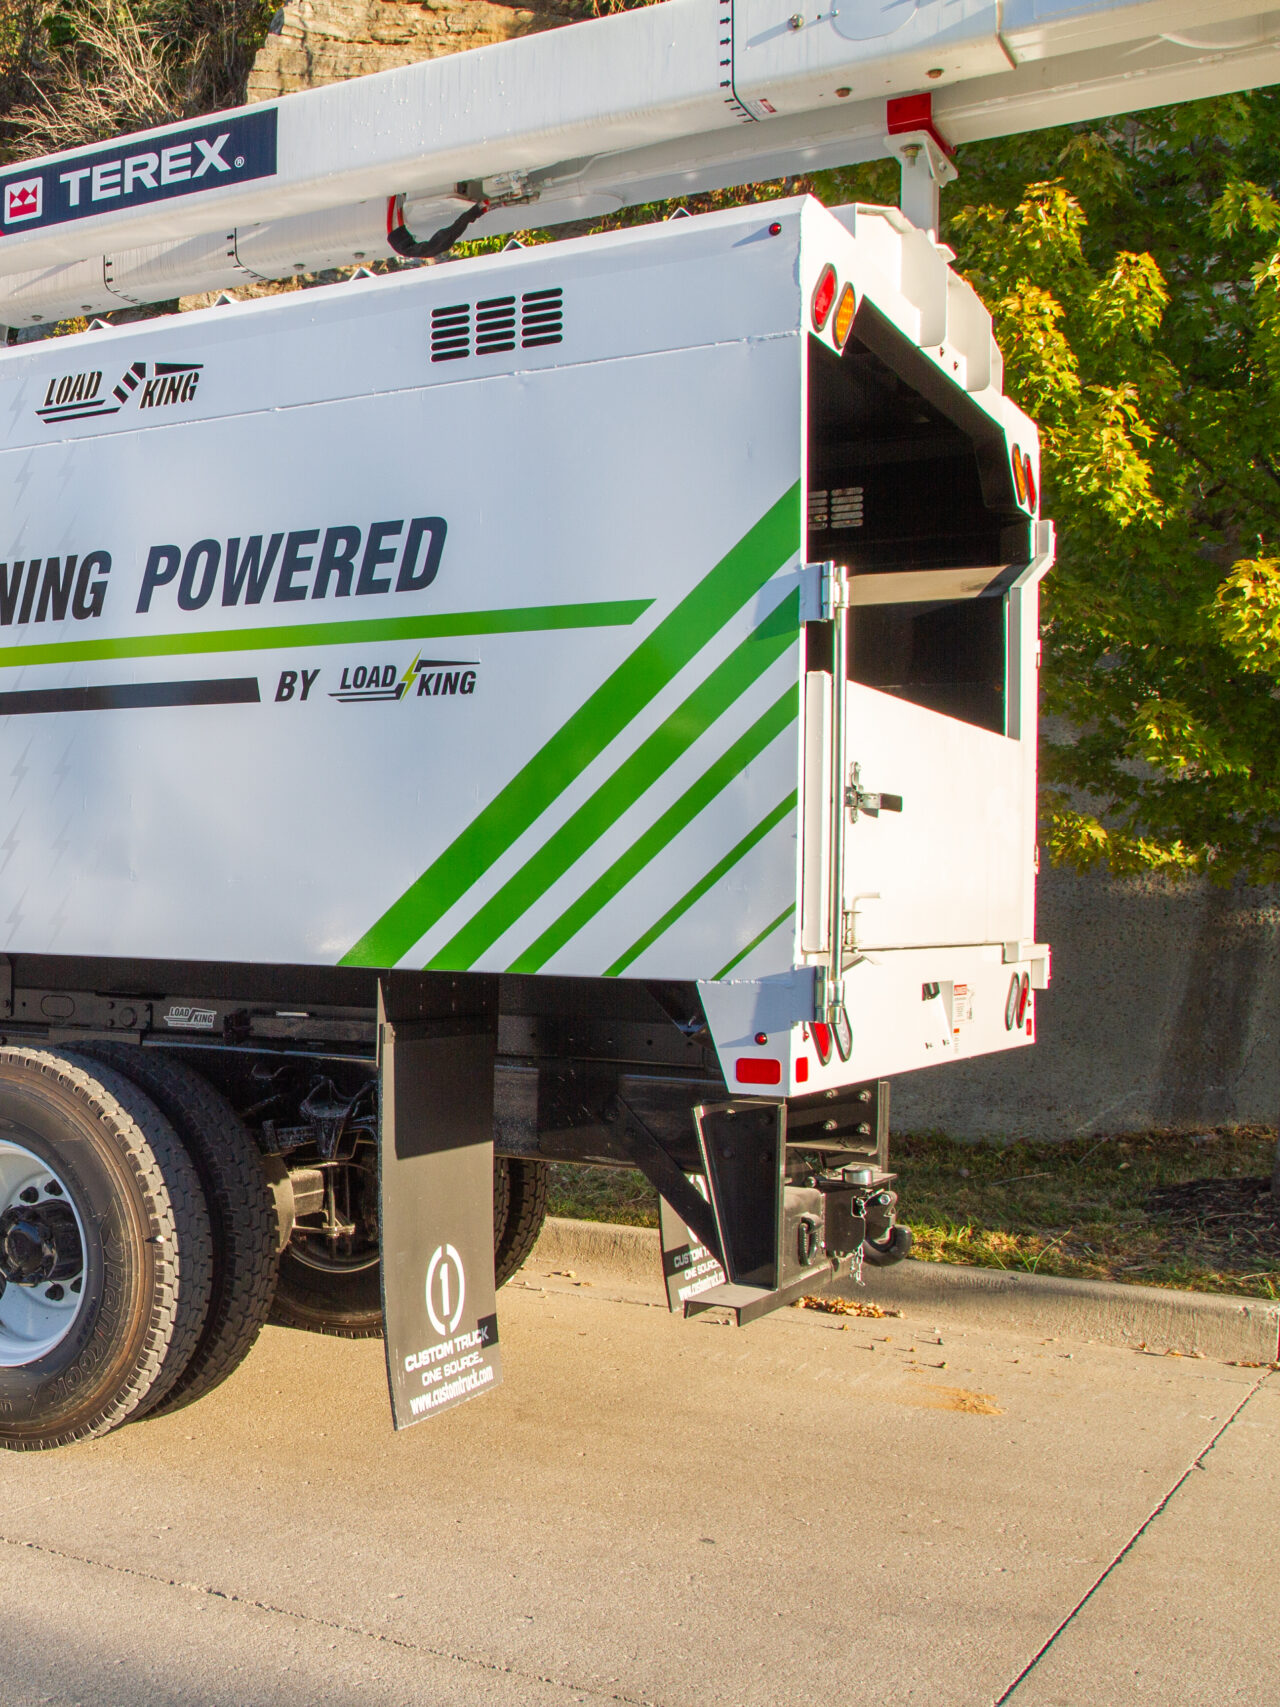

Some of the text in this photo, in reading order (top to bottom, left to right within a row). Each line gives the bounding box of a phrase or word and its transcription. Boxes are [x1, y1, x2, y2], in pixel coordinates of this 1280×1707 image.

[59, 133, 231, 207] TEREX
[43, 370, 200, 410] LOAD KING
[135, 515, 449, 614] POWERED
[274, 664, 477, 703] BY LOAD KING
[170, 1007, 213, 1024] LOAD KING
[684, 1267, 697, 1280] ONE
[404, 1326, 489, 1372] CUSTOM TRUCK
[410, 1365, 494, 1415] www.customtruck.com
[422, 1367, 443, 1387] ONE
